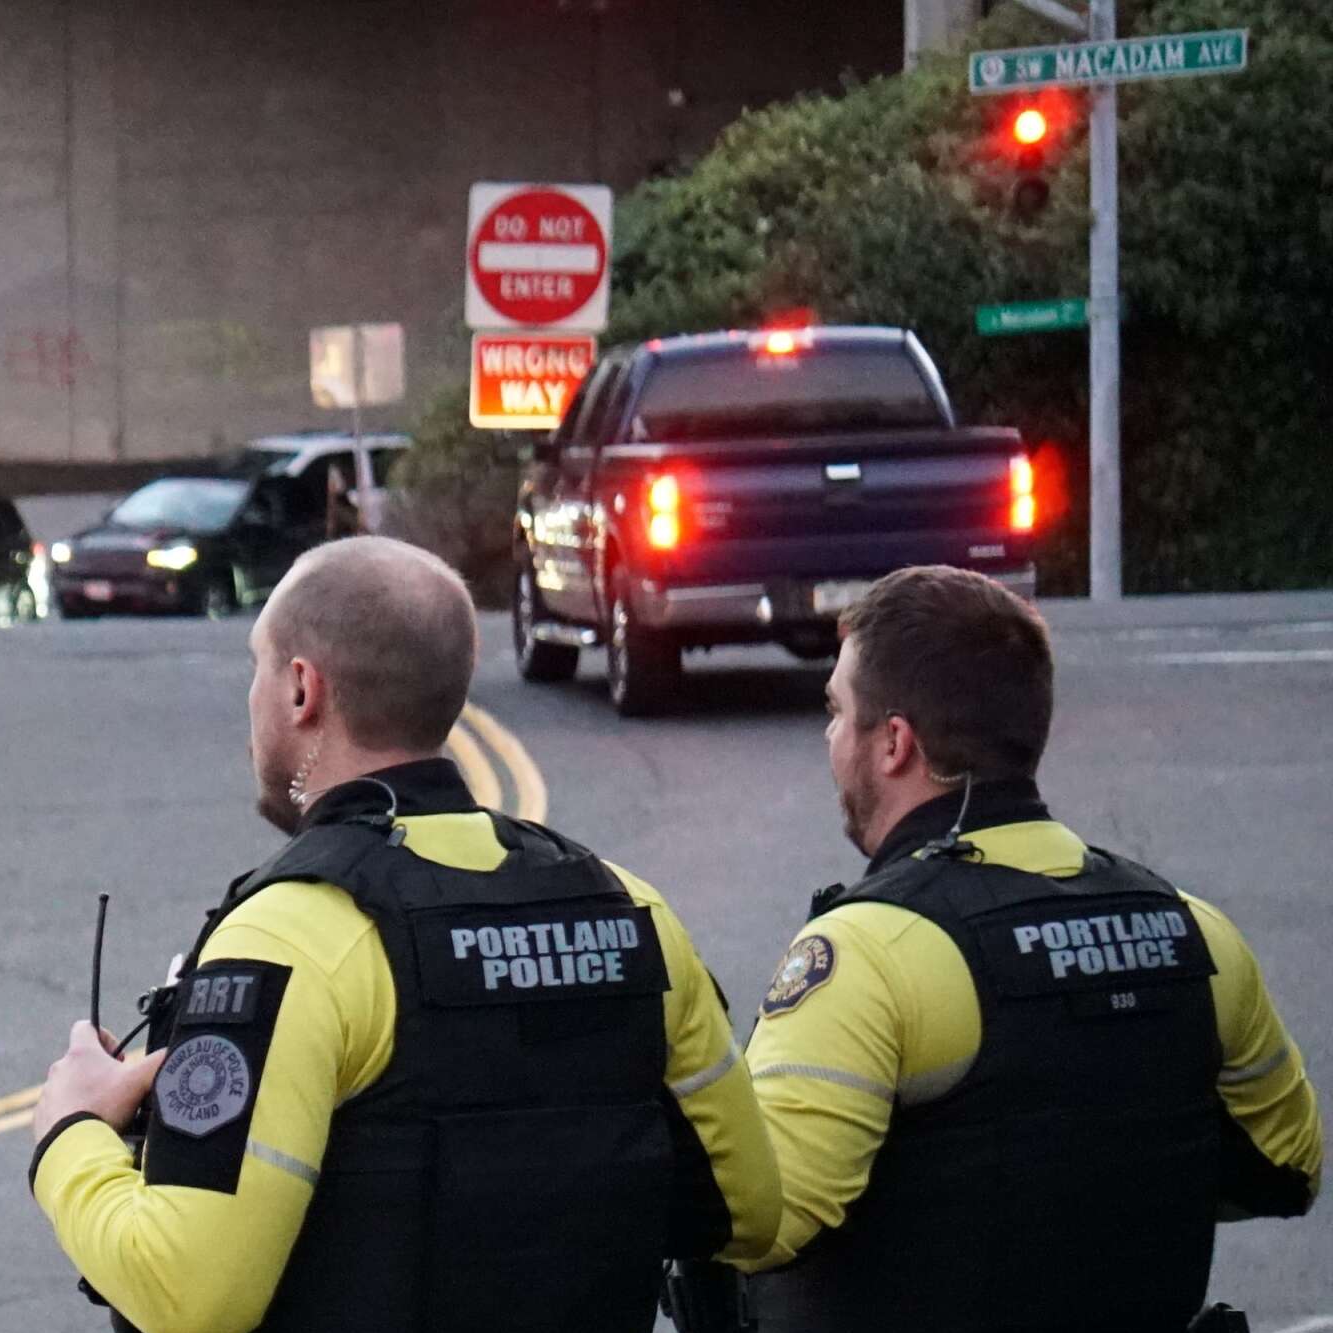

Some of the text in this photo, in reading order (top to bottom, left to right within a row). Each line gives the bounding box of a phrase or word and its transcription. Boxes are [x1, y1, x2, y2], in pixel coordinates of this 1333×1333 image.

[1016, 41, 1233, 79] SW MACADAM AVE
[494, 215, 586, 238] DO NOT
[500, 275, 575, 299] ENTER
[481, 344, 591, 377] WRONG
[501, 381, 567, 414] WAY
[450, 918, 639, 959] PORTLAND
[1013, 911, 1187, 954] PORTLAND
[482, 951, 625, 990] POLICE
[1049, 939, 1179, 979] POLICE
